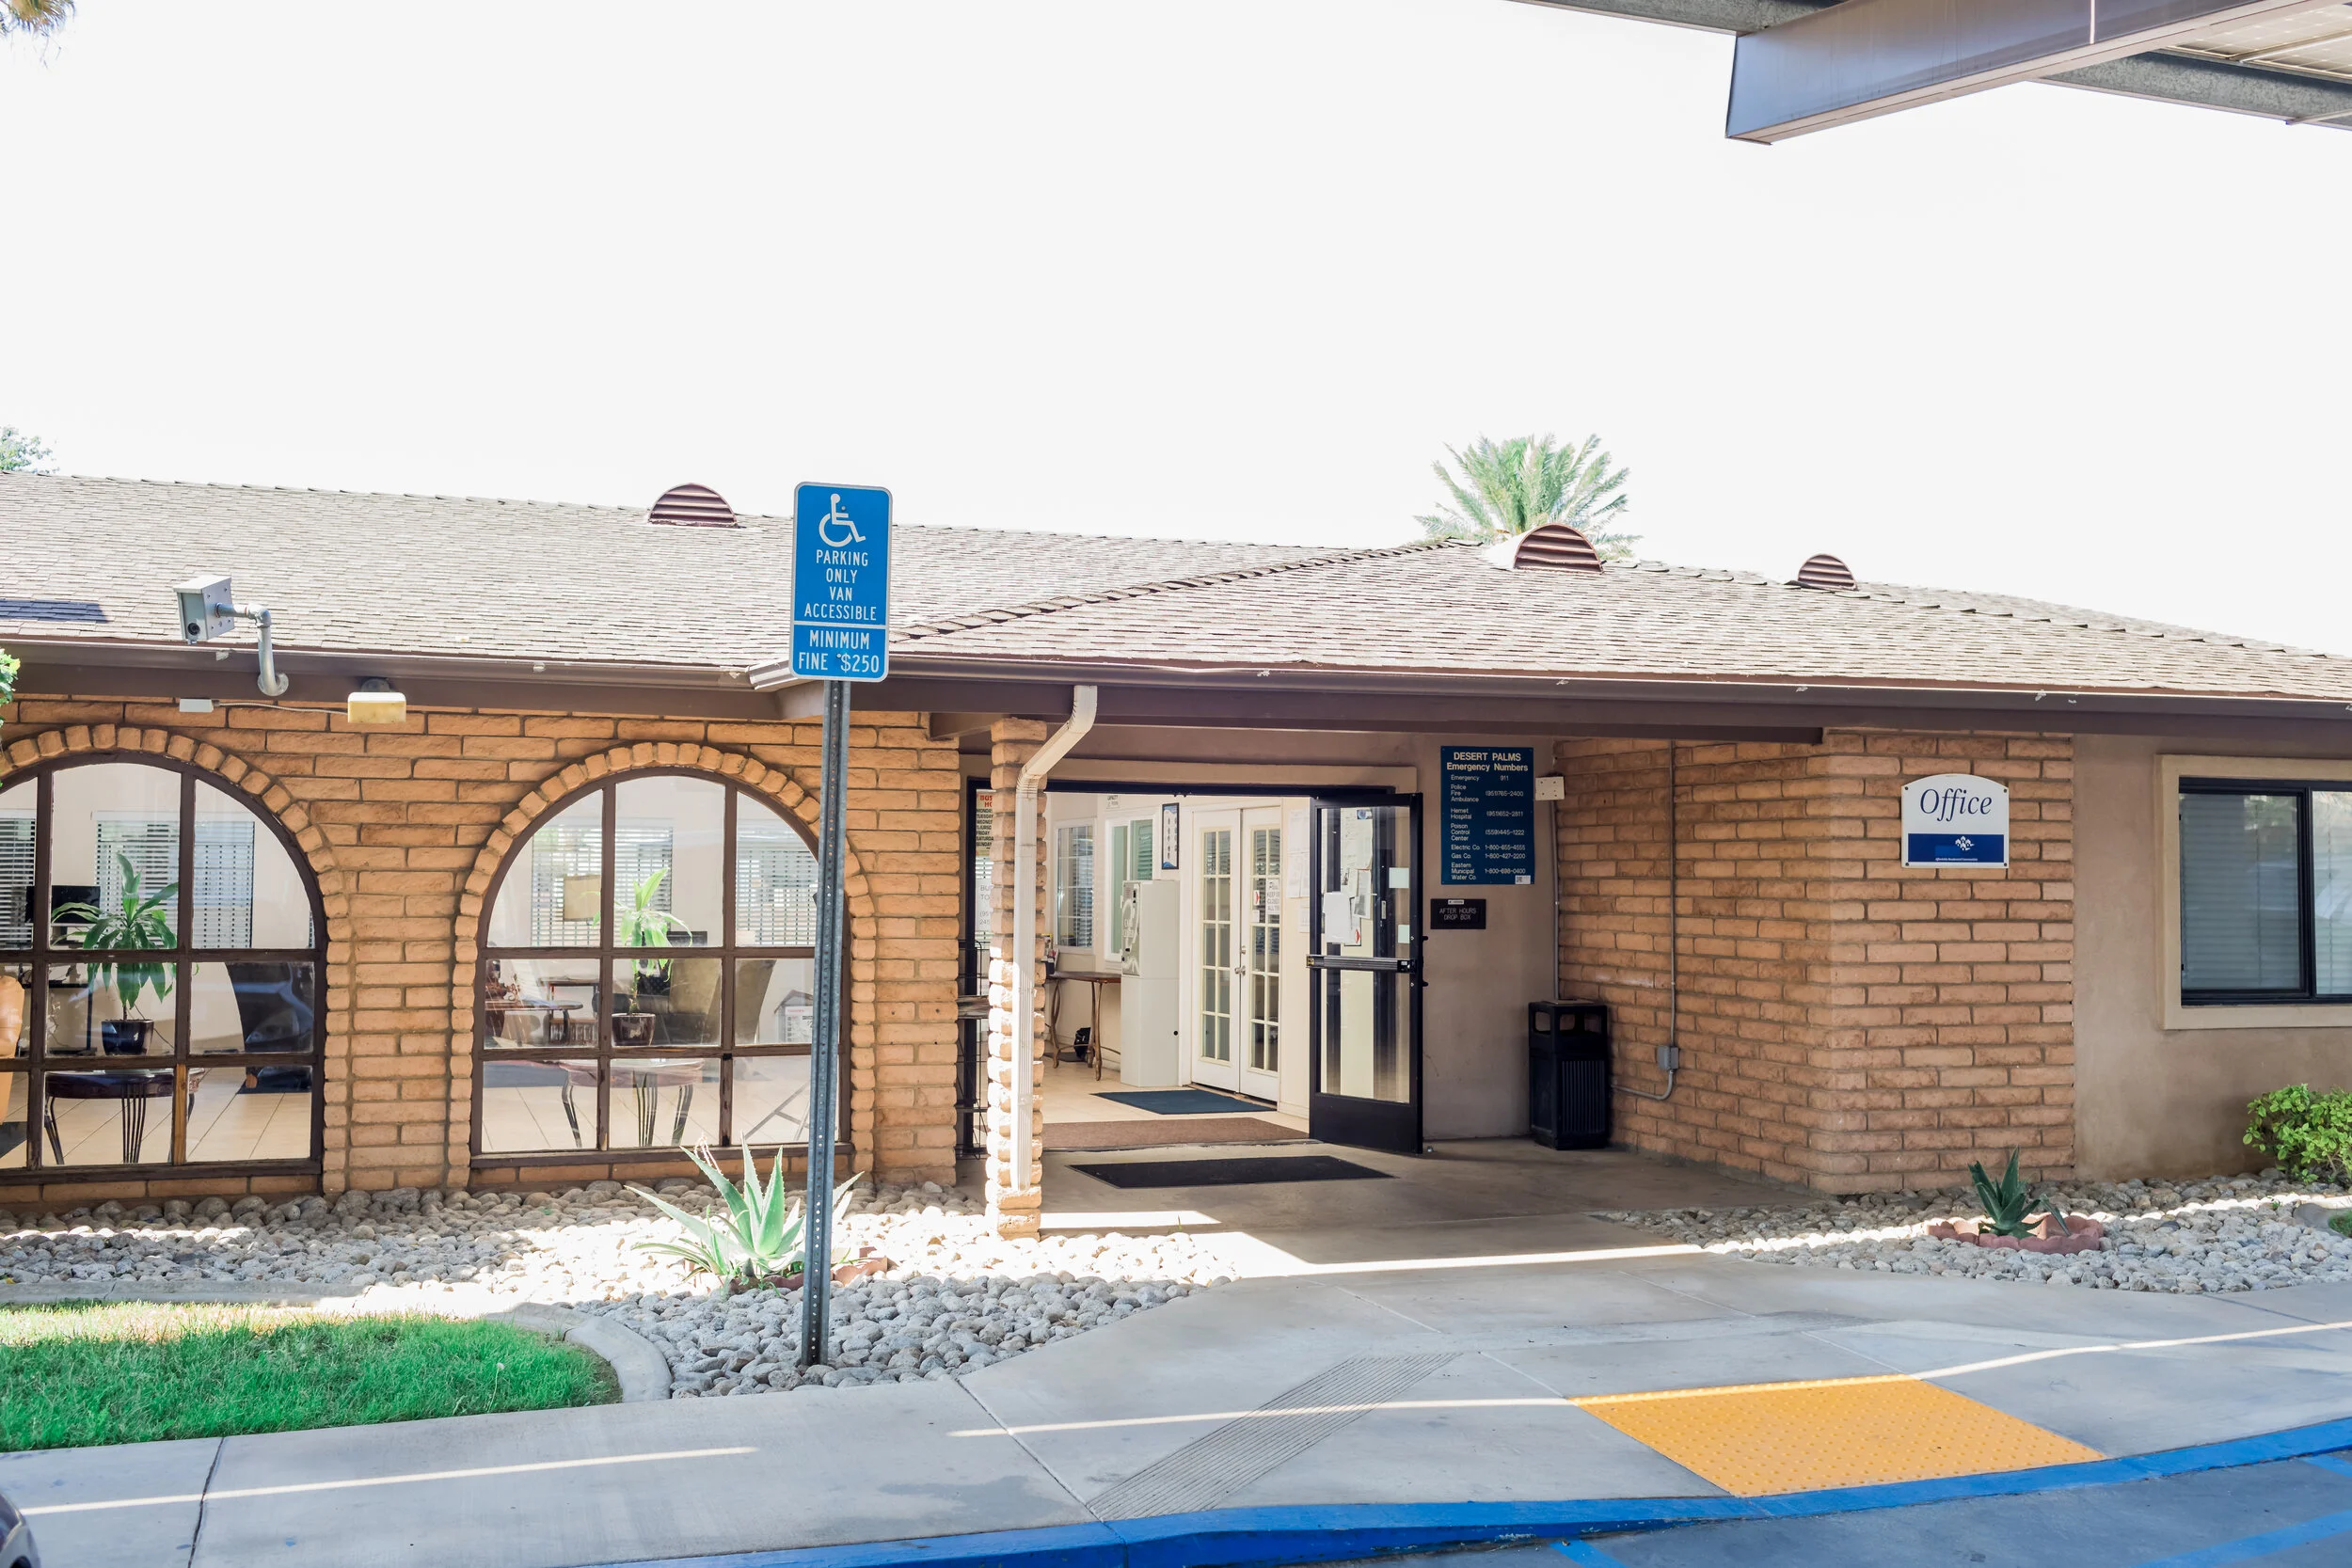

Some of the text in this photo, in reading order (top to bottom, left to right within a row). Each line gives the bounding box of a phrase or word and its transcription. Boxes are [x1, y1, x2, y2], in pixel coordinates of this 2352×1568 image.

[817, 549, 867, 566] PARKING
[826, 568, 857, 583] ONLY
[830, 587, 852, 601] VAN
[804, 603, 877, 621] ACCESSIBLE
[810, 630, 869, 649] MINIMUM
[799, 652, 879, 673] FINE $250
[1453, 752, 1521, 762] DESERT PALMS
[1446, 761, 1528, 772] Emergency Numbers
[1920, 788, 1992, 822] Office
